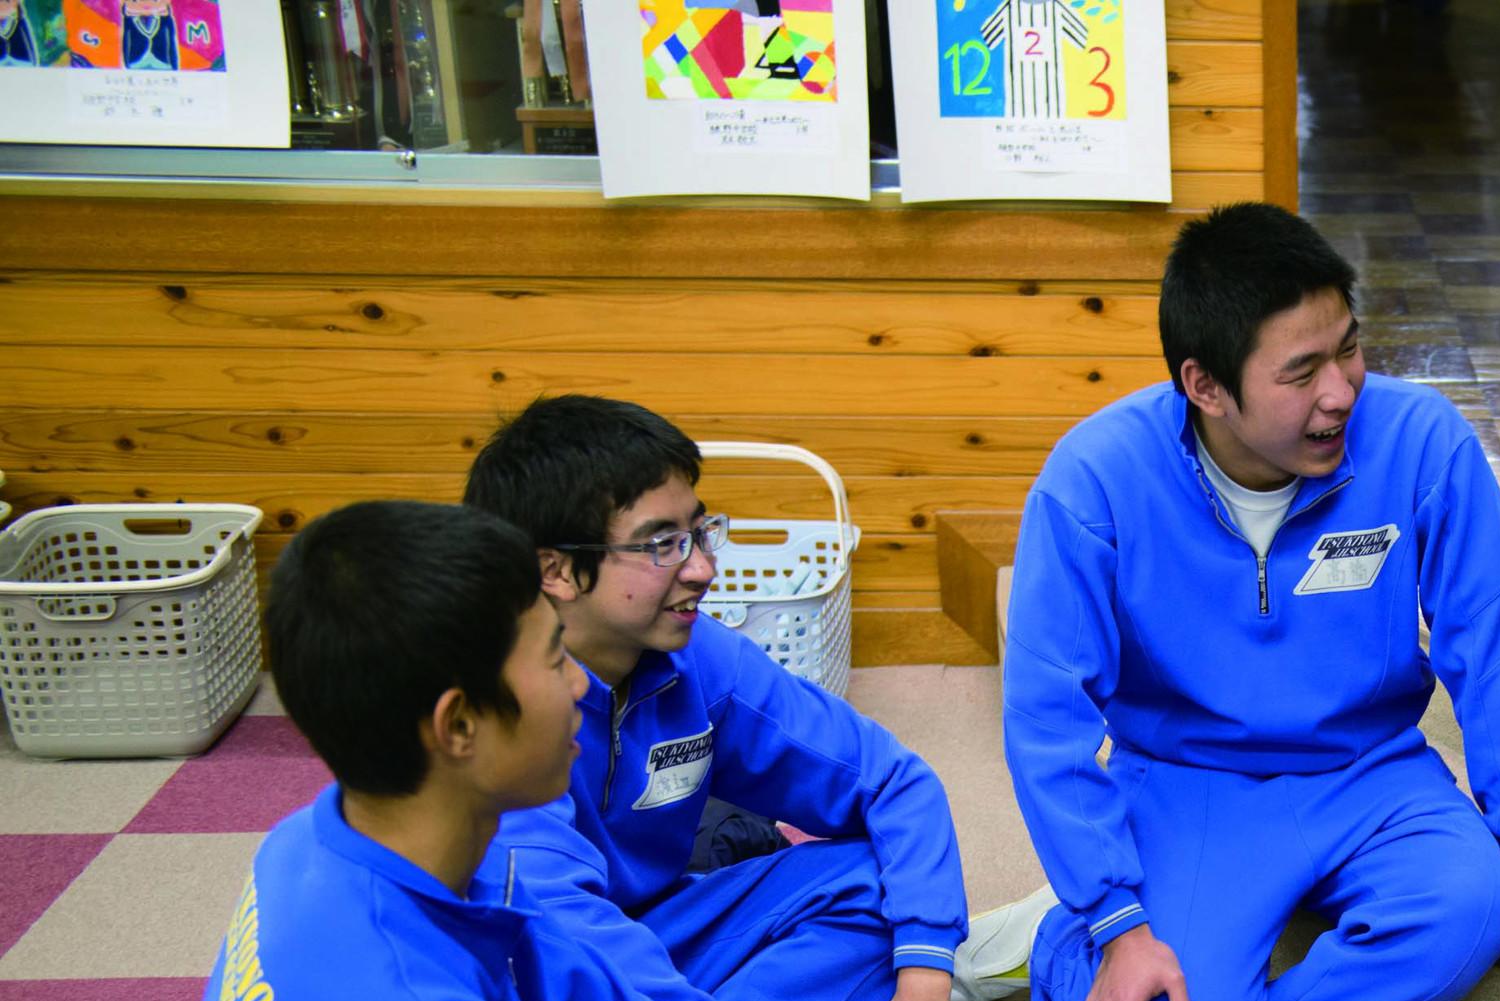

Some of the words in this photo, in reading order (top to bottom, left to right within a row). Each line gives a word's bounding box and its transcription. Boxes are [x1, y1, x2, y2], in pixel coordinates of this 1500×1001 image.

[187, 22, 209, 44] M
[1024, 31, 1045, 55] 2
[944, 40, 993, 95] 12
[1088, 47, 1115, 117] 3
